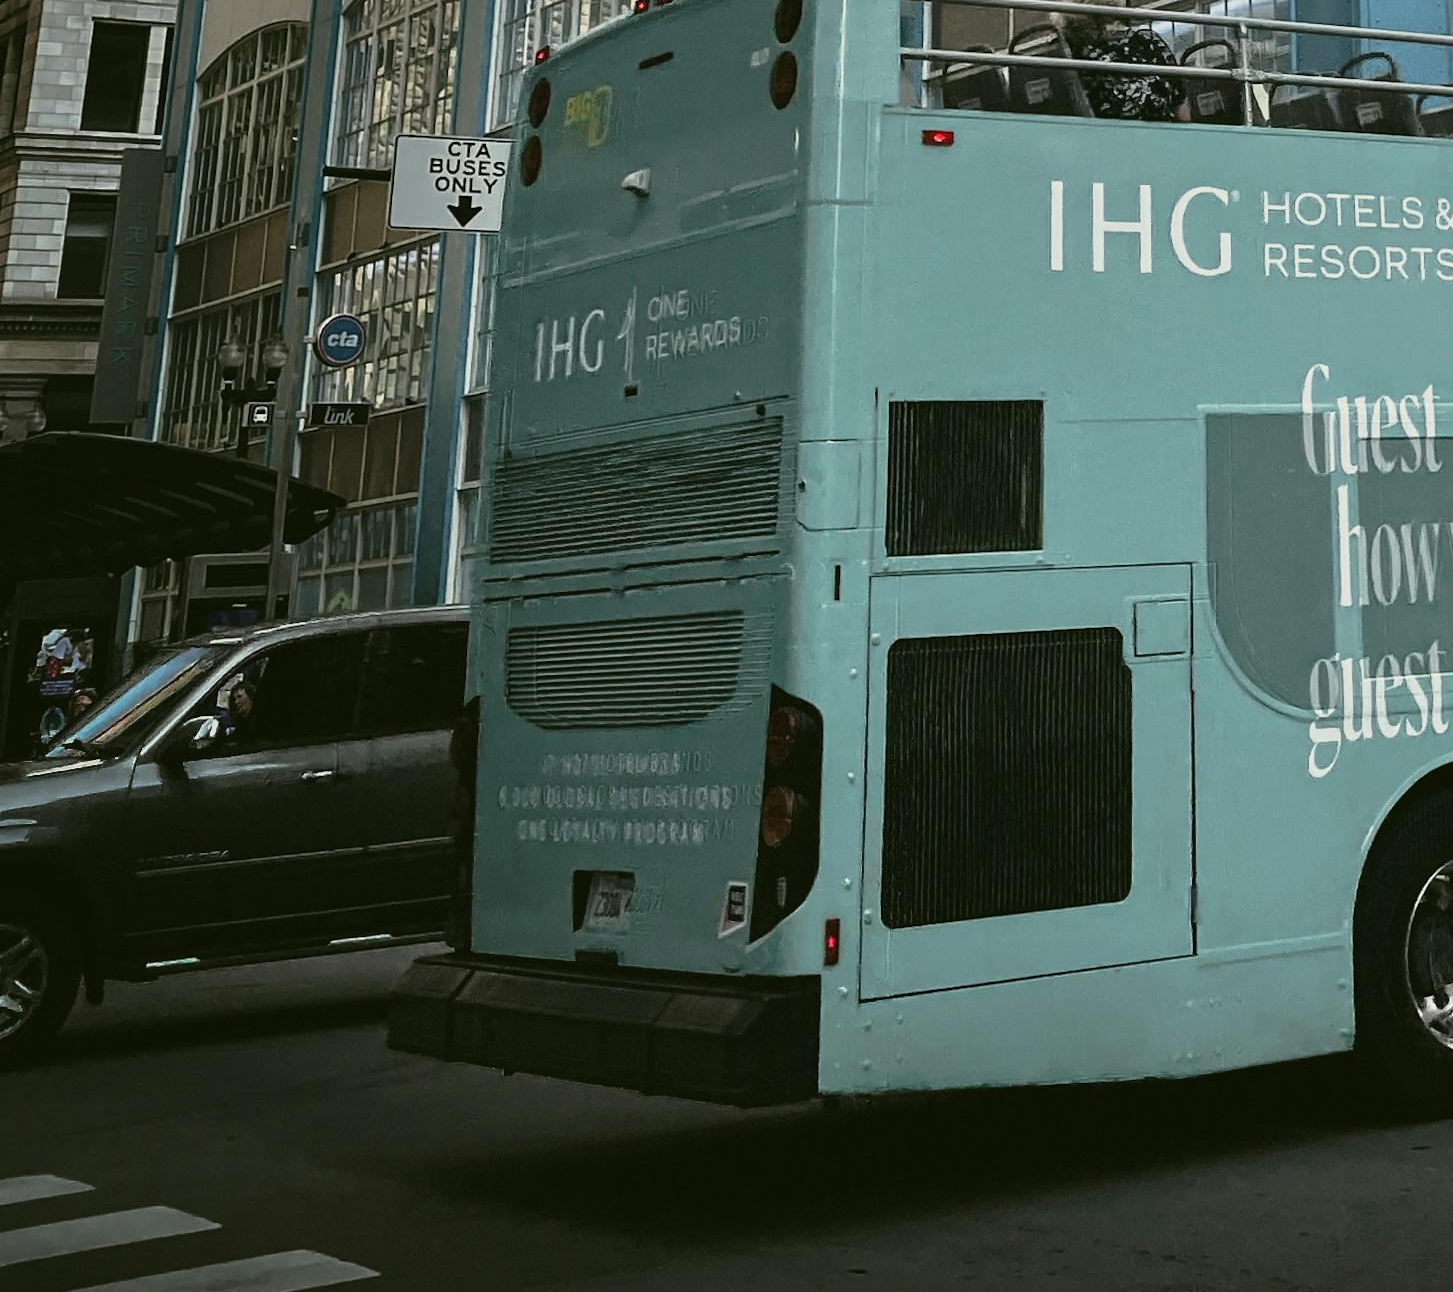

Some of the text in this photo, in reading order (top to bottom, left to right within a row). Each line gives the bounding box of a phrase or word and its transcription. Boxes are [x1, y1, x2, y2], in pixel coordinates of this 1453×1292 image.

[429, 158, 506, 177] BUSES
[434, 176, 498, 195] ONLY
[447, 141, 491, 159] CTA
[1050, 180, 1232, 277] IHG
[1262, 190, 1425, 230] HOTELS
[111, 200, 150, 365] PRIMARK
[327, 331, 359, 348] cta
[533, 309, 605, 382] IHG
[645, 316, 742, 361] REWARDS
[1301, 363, 1444, 476] Guest
[1336, 483, 1441, 607] how
[1308, 639, 1449, 779] guest
